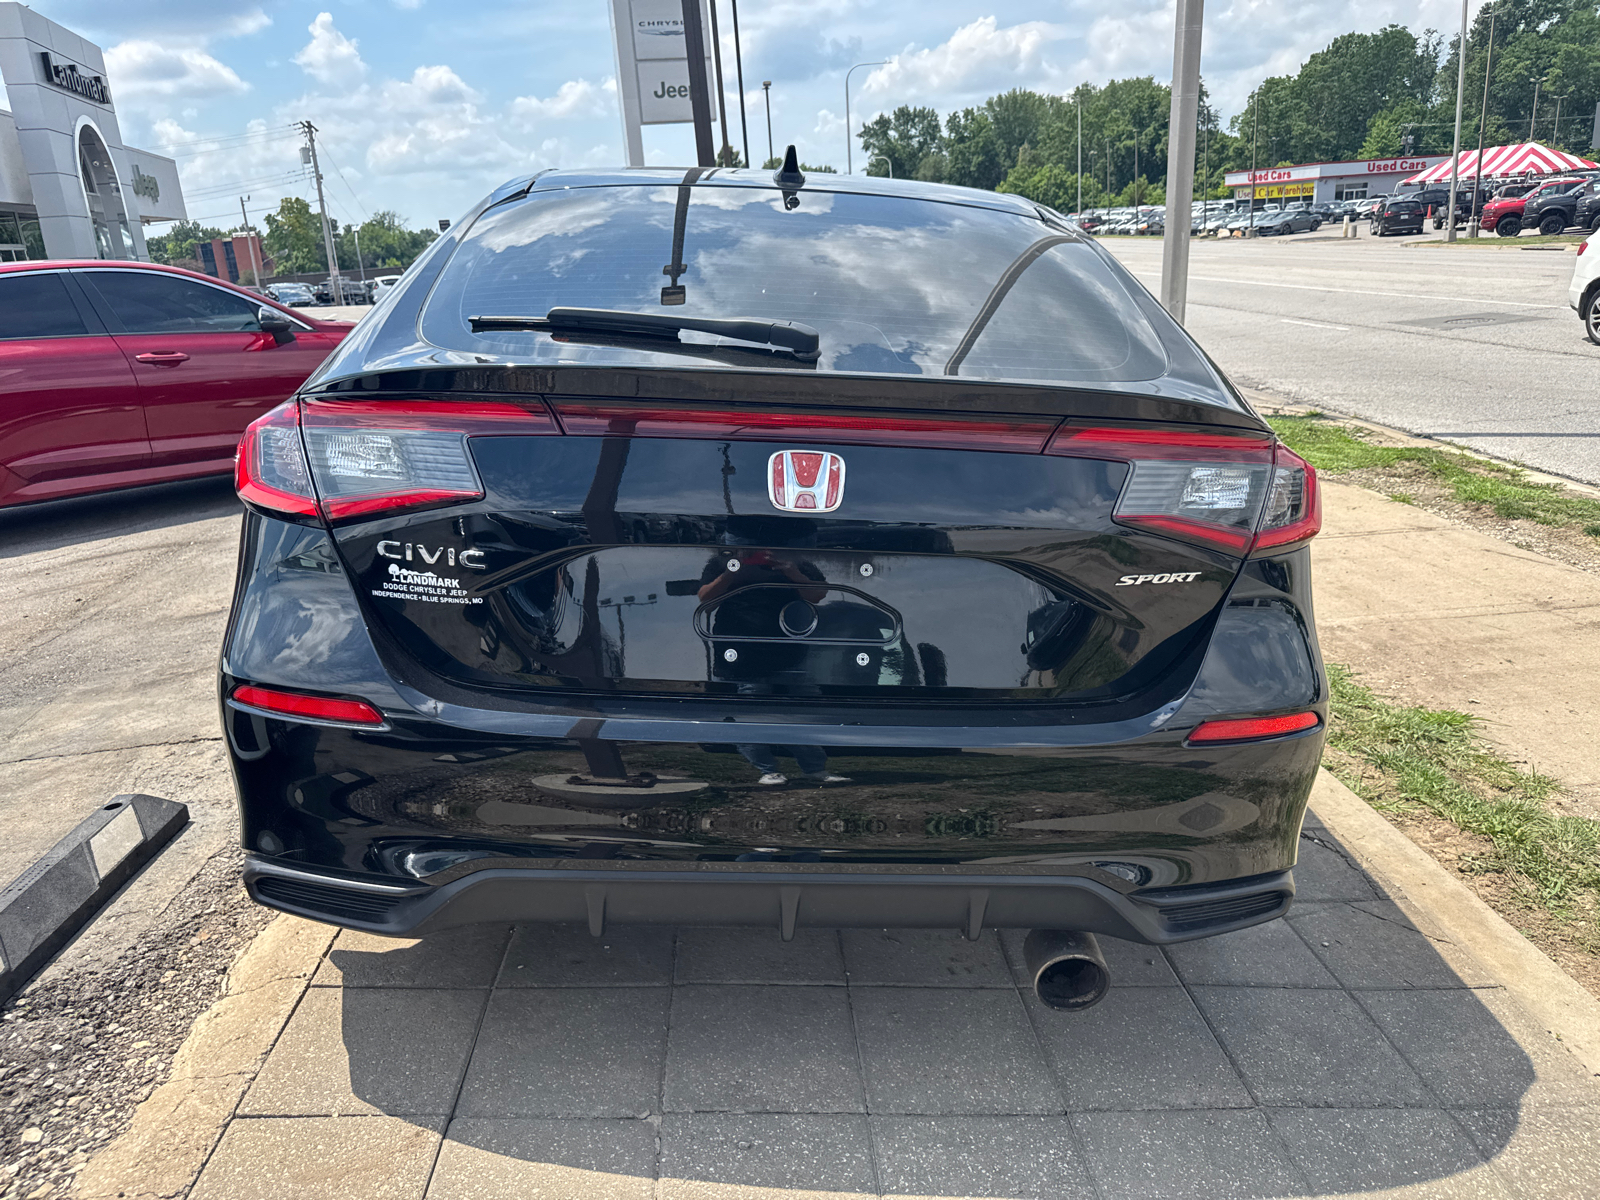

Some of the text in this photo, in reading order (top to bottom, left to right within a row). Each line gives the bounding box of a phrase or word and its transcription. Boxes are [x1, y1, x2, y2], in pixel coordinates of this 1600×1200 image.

[40, 51, 111, 105] Landmark
[1367, 160, 1427, 172] Used Cars
[1247, 170, 1291, 182] Used Cars
[1258, 187, 1274, 197] Car
[1277, 185, 1315, 196] Warehous
[377, 540, 486, 569] CIVIC
[400, 574, 460, 588] LANDMARK
[1115, 572, 1202, 586] SPORT
[383, 582, 468, 597] DODGE CHRYSLER JEEP
[422, 595, 438, 603] BLUE
[440, 597, 472, 605] SPRINGS,
